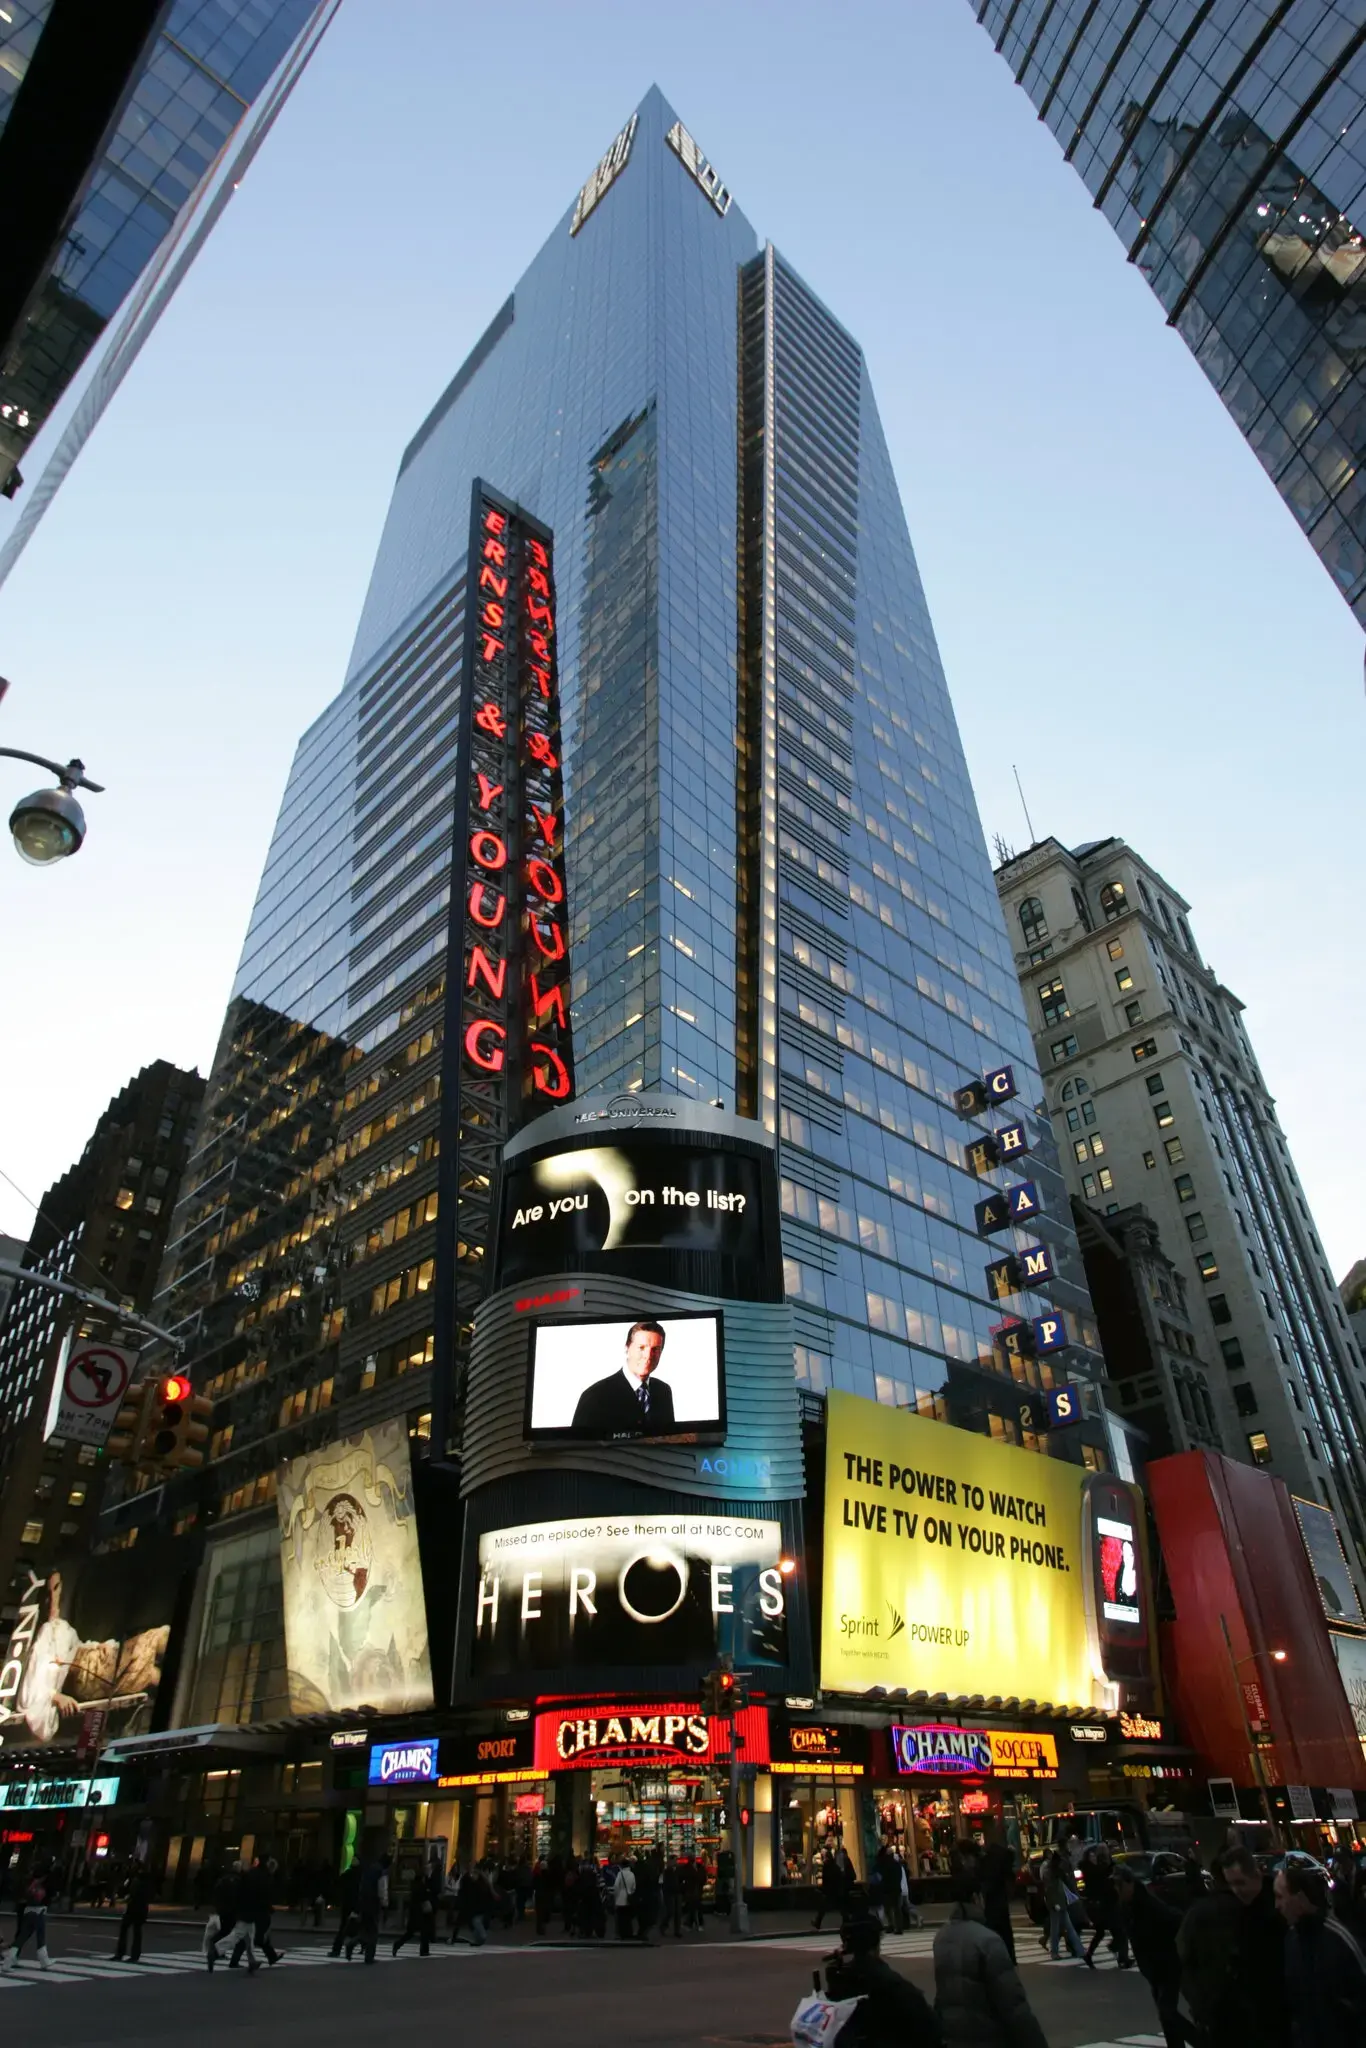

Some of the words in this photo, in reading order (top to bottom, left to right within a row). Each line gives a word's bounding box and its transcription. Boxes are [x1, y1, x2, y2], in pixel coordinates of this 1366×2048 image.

[479, 512, 506, 662] ERNST
[476, 702, 505, 738] &
[464, 773, 507, 1073] YOUNG
[609, 1107, 677, 1119] UNIVERSAL
[512, 1204, 543, 1229] Are
[548, 1193, 589, 1221] you
[624, 1187, 655, 1205] on
[662, 1186, 700, 1207] the
[707, 1189, 746, 1213] list?
[844, 1452, 883, 1487] THE
[889, 1464, 957, 1505] POWER
[962, 1484, 984, 1511] TO
[989, 1490, 1046, 1527] WATCH
[494, 1532, 527, 1549] Missed
[531, 1531, 544, 1543] an
[548, 1526, 602, 1542] episode?
[606, 1524, 630, 1537] See
[634, 1523, 667, 1536] them
[671, 1524, 686, 1536] all
[690, 1524, 702, 1536] at
[843, 1499, 887, 1533] LIVE
[893, 1509, 918, 1540] TV
[923, 1517, 952, 1547] ON
[957, 1524, 1005, 1558] YOUR
[1010, 1540, 1070, 1572] PHONE.
[476, 1549, 784, 1626] HEROES
[840, 1614, 879, 1638] Sprint
[911, 1624, 952, 1646] POWER
[955, 1628, 970, 1647] UP
[477, 1737, 517, 1760] SPORT
[557, 1714, 710, 1759] CHAMPS
[901, 1728, 992, 1767] CHAMPS
[995, 1738, 1045, 1760] SOCCER
[381, 1747, 432, 1779] CHAMPS
